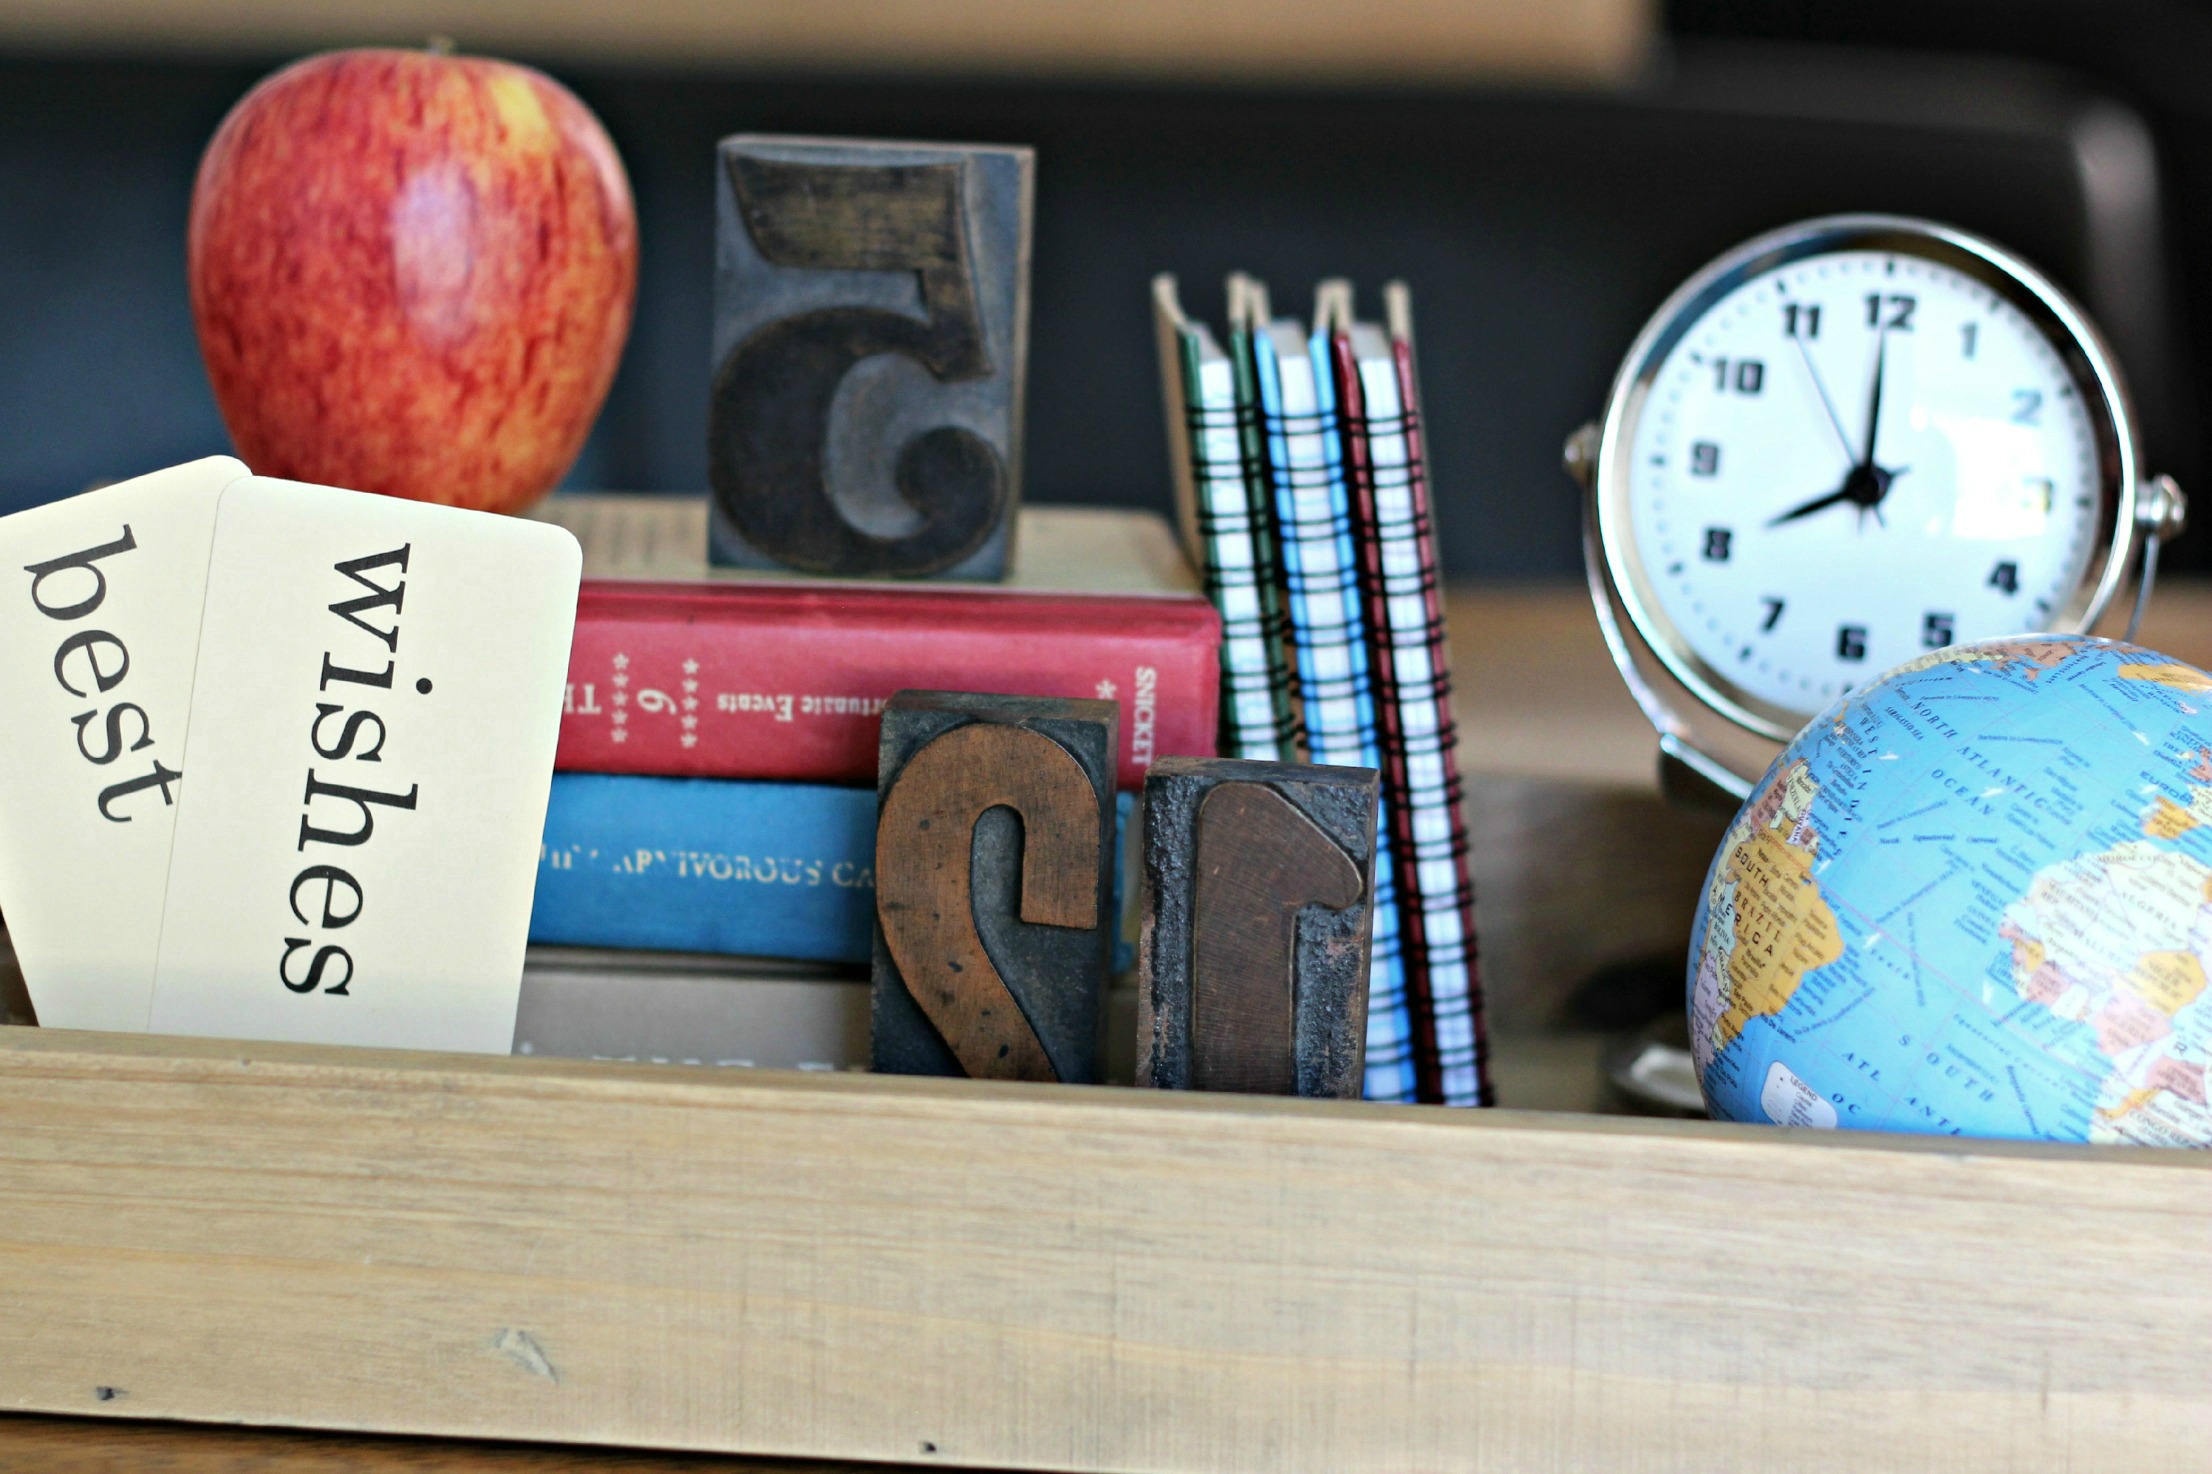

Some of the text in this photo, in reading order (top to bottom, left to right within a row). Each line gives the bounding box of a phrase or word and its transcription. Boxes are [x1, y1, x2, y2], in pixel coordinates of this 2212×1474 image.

[1782, 303, 1822, 340] 11
[1865, 293, 1917, 331] 12
[1960, 321, 1979, 359] 1
[1713, 356, 1765, 396] 10
[2010, 388, 2043, 426] 2
[1691, 441, 1720, 477] 9
[1704, 526, 1733, 562] 8
[1986, 559, 2020, 597] 4
[1760, 597, 1787, 632] 7
[1922, 612, 1956, 649] 5
[1838, 624, 1867, 661] 6
[23, 523, 183, 823] best
[716, 692, 795, 722] Events
[1131, 665, 1157, 766] SNICKET
[1911, 700, 1958, 739] NORTH
[279, 542, 434, 997] wishes
[1956, 745, 2047, 809] ATLANTIC
[1931, 768, 1995, 816] OCEAN
[1734, 846, 1770, 887] SOUTH
[1711, 885, 1776, 957] AMERICA
[1734, 890, 1782, 944] BRAZIL
[1788, 1075, 1819, 1102] LEGEND
